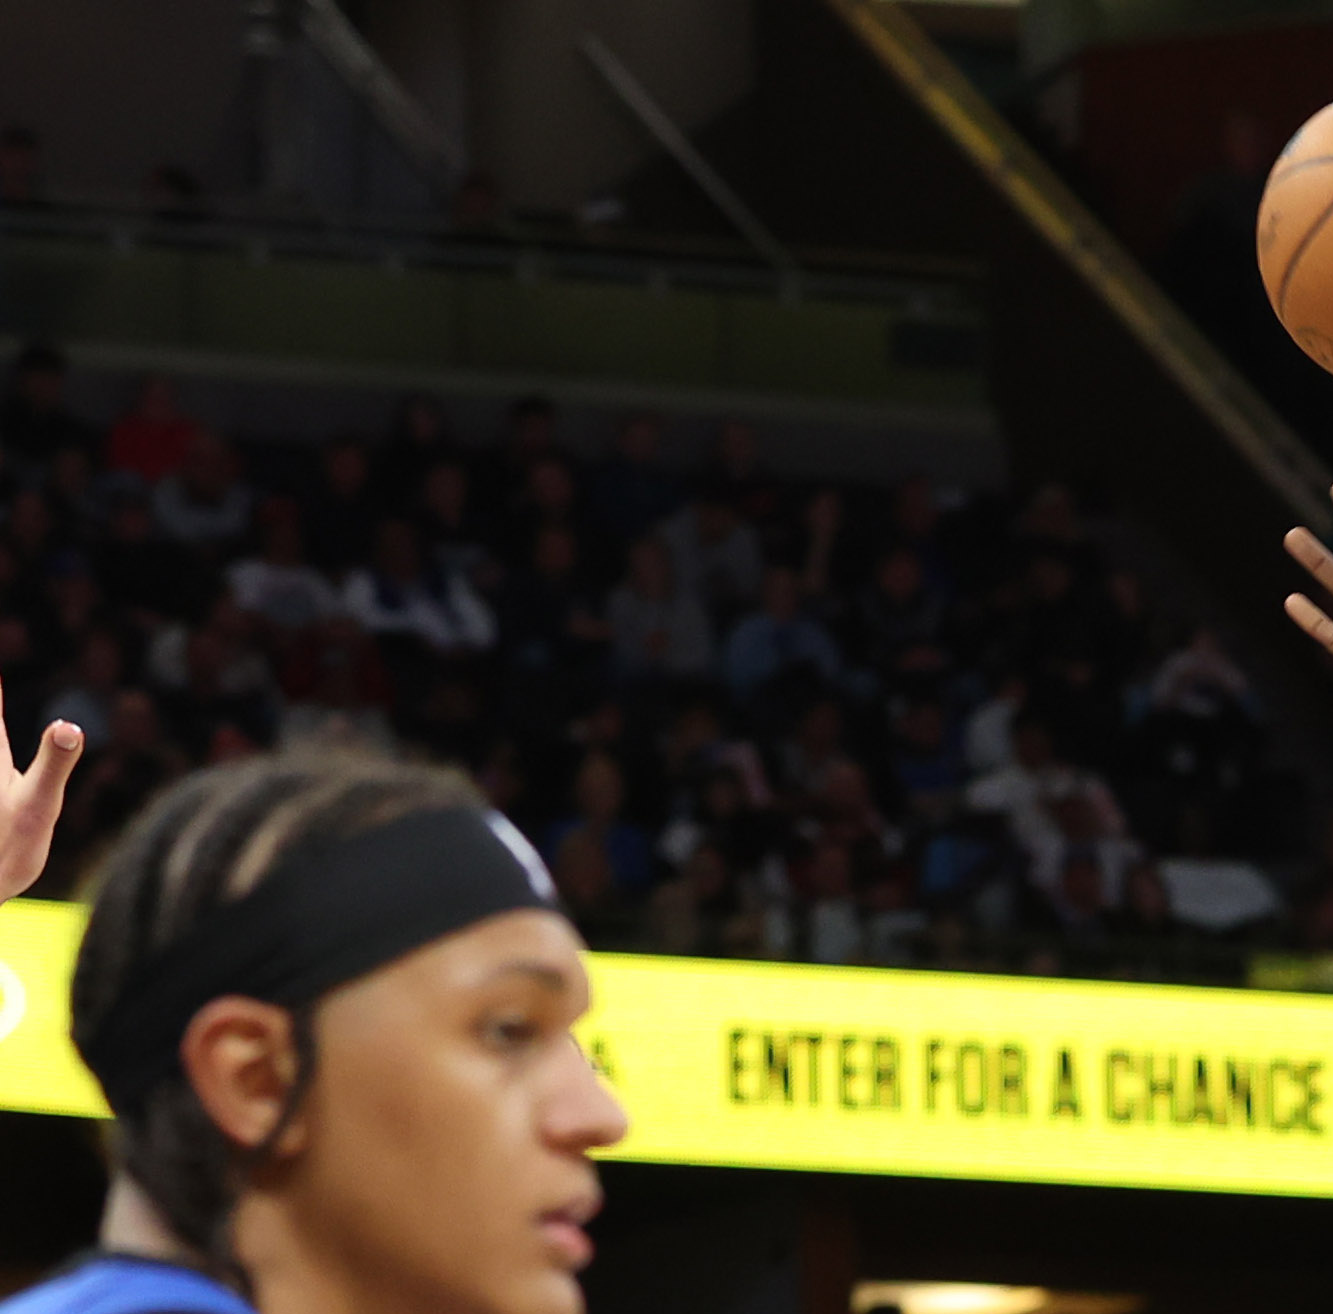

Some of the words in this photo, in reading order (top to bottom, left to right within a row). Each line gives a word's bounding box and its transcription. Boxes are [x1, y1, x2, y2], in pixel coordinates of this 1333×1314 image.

[730, 1026, 899, 1109] ENTER
[927, 1038, 1028, 1118] FOR
[1050, 1046, 1081, 1121] A
[1106, 1048, 1323, 1136] CHANCE
